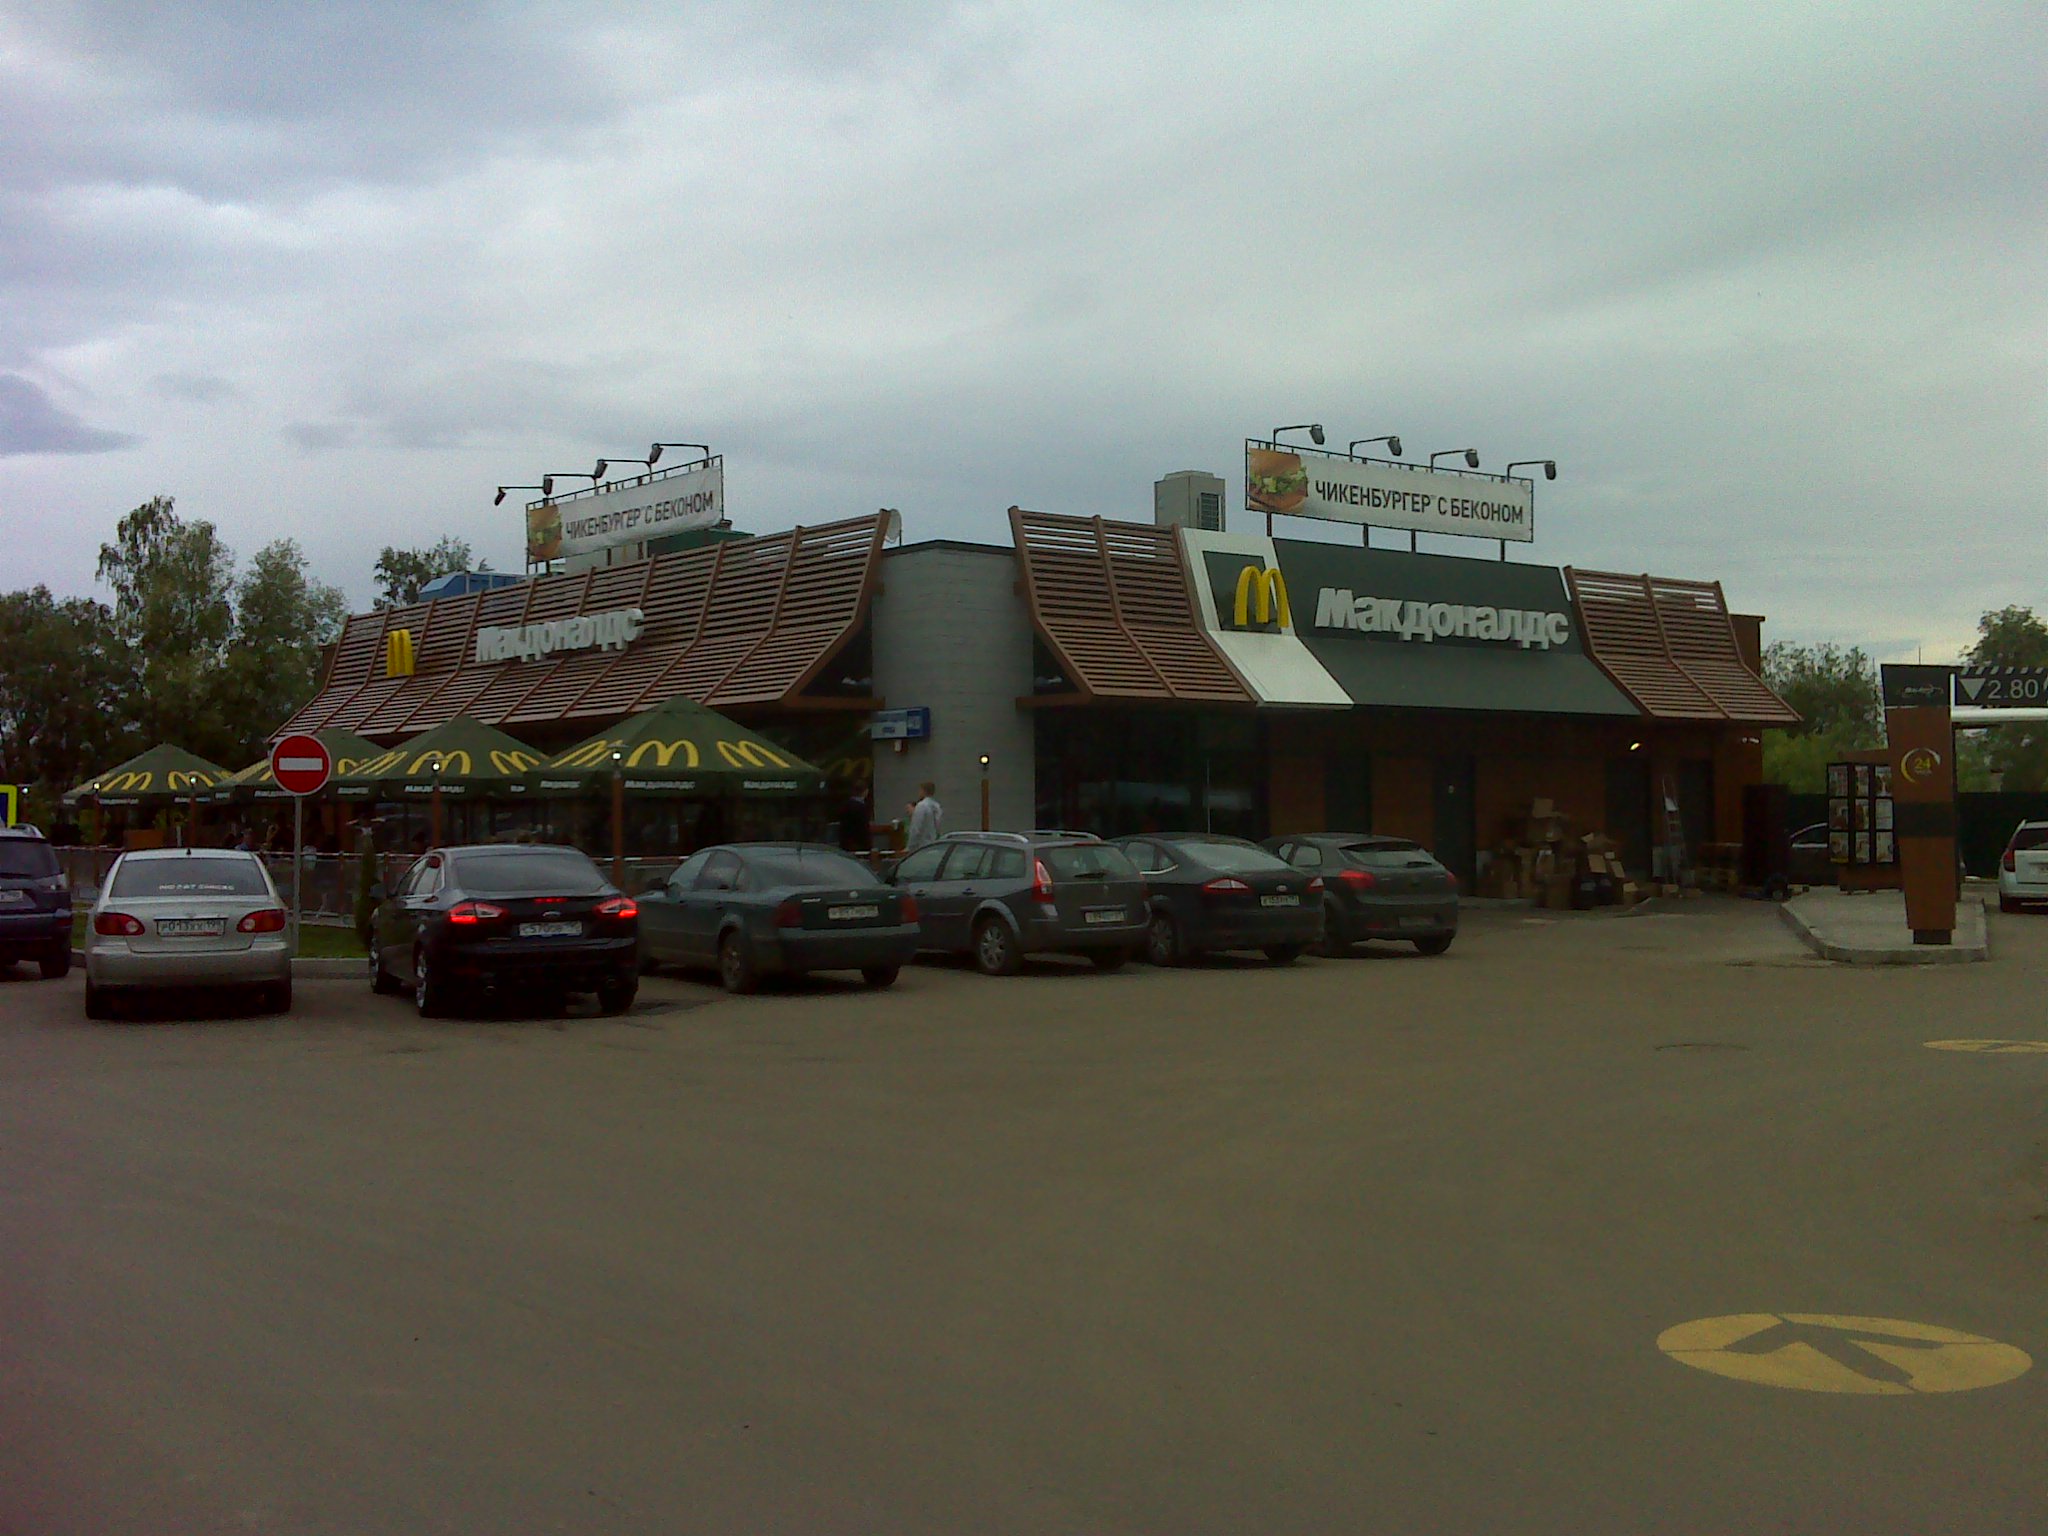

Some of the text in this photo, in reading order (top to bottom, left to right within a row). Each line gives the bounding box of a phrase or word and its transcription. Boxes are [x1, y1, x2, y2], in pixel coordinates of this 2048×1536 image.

[565, 507, 641, 540] ЧИКЕНБУРГЕР
[655, 491, 713, 522] БЕКОНОМ
[1315, 479, 1431, 513] ЧИКЕНБУРГЕР
[1450, 498, 1523, 524] БЕКОНОМ
[475, 608, 645, 663] Макдоналдс
[1315, 588, 1569, 650] Макдоналдс
[1988, 680, 2039, 699] 2.80
